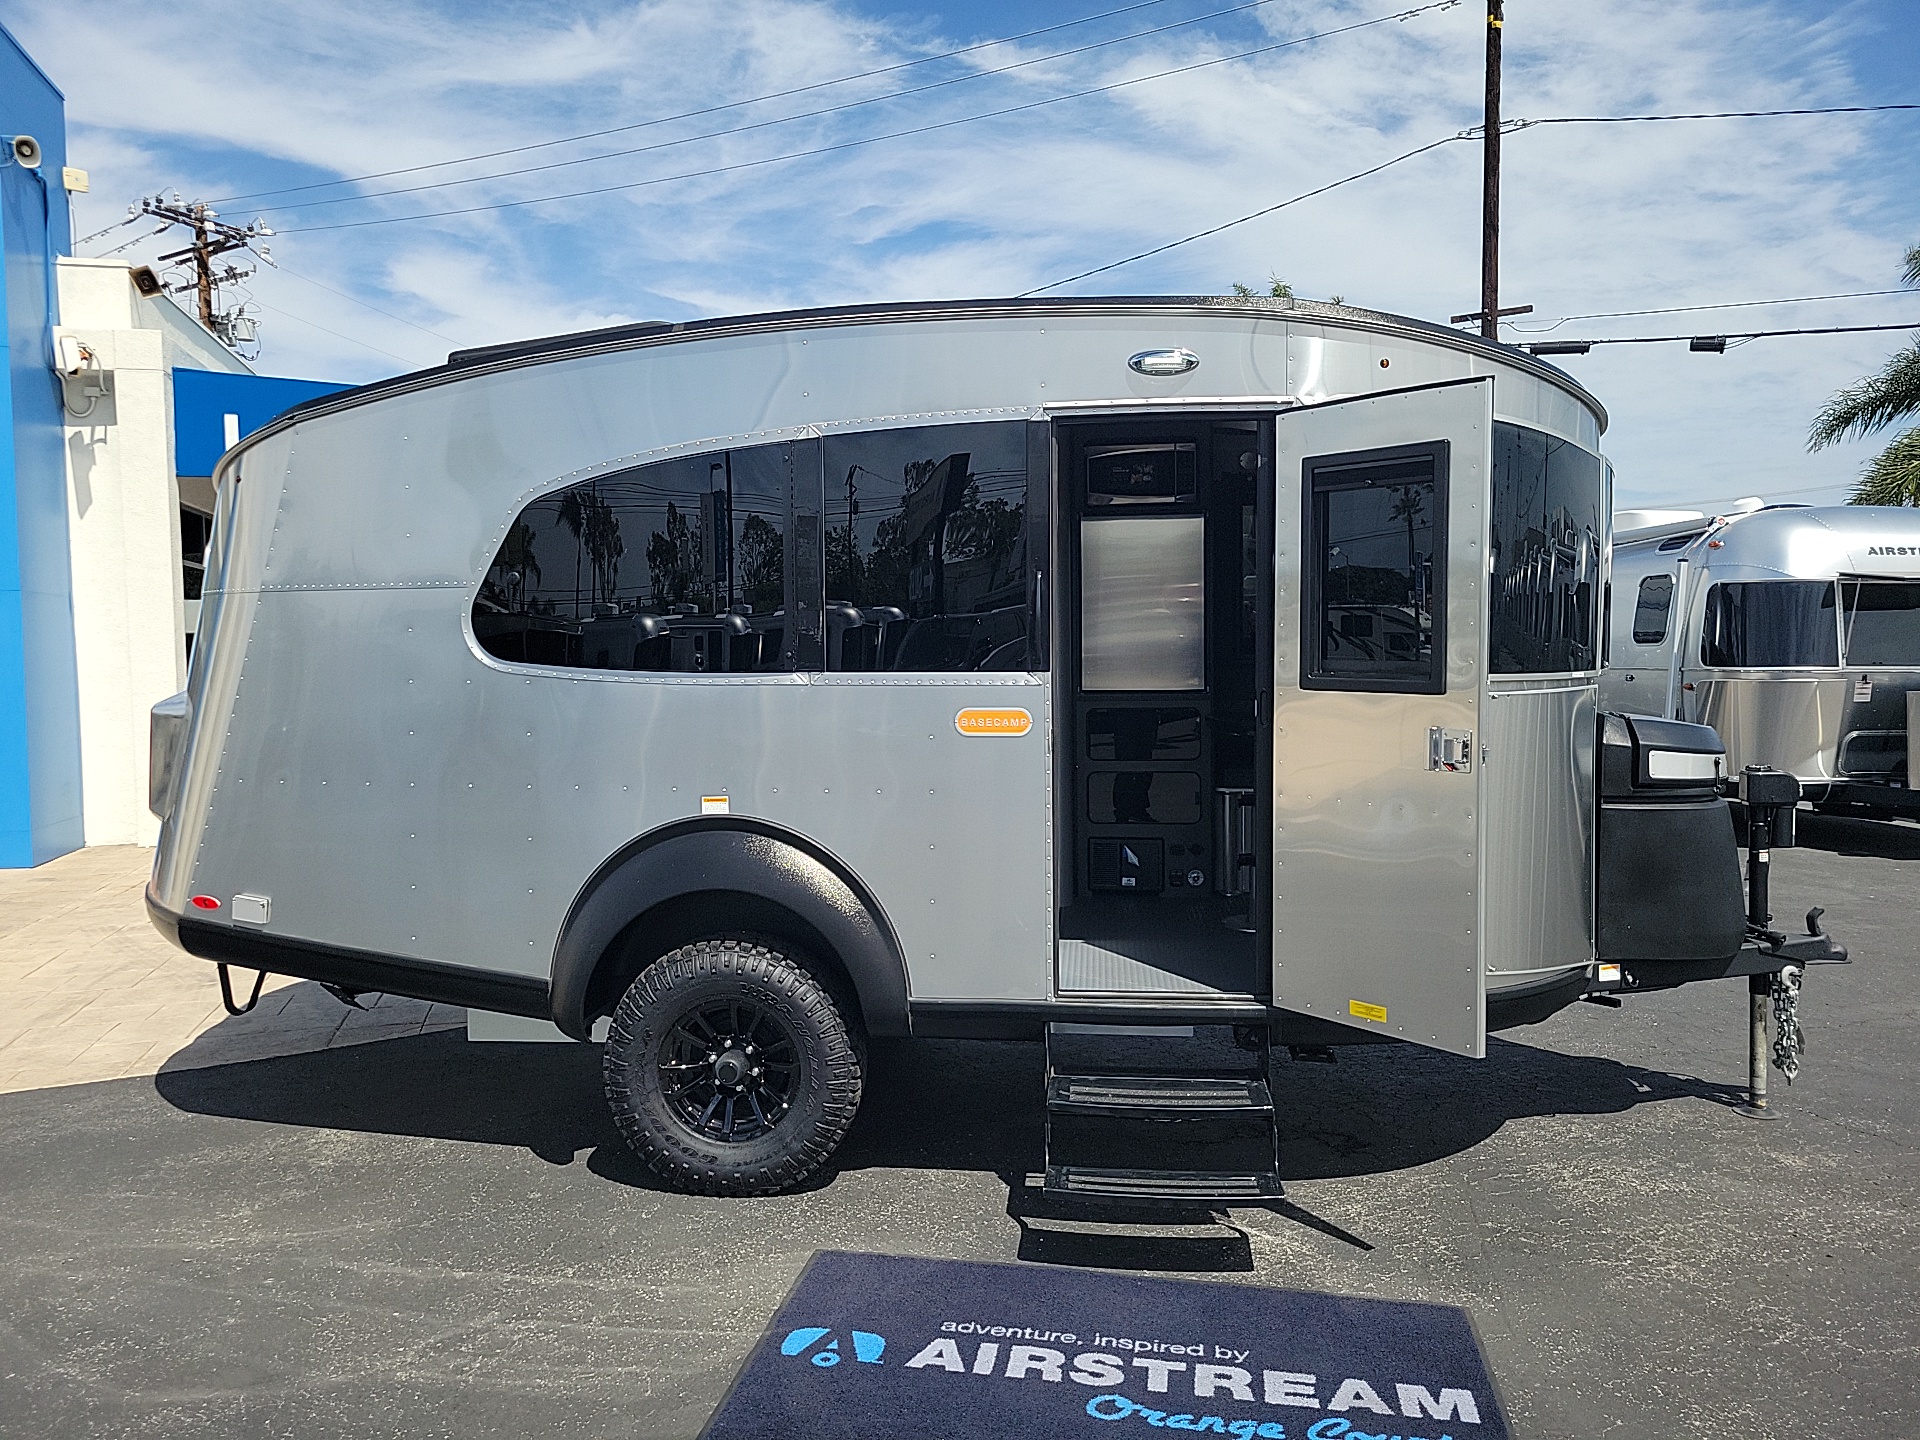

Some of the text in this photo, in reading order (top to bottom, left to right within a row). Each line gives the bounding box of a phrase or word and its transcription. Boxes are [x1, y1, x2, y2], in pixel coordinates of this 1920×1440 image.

[1867, 546, 1920, 556] AIRST
[961, 718, 1027, 727] BASECAMP
[940, 1320, 1250, 1363] adventure, inspired by
[903, 1338, 1481, 1424] AIRSTREAM
[1086, 1394, 1287, 1440] Orange
